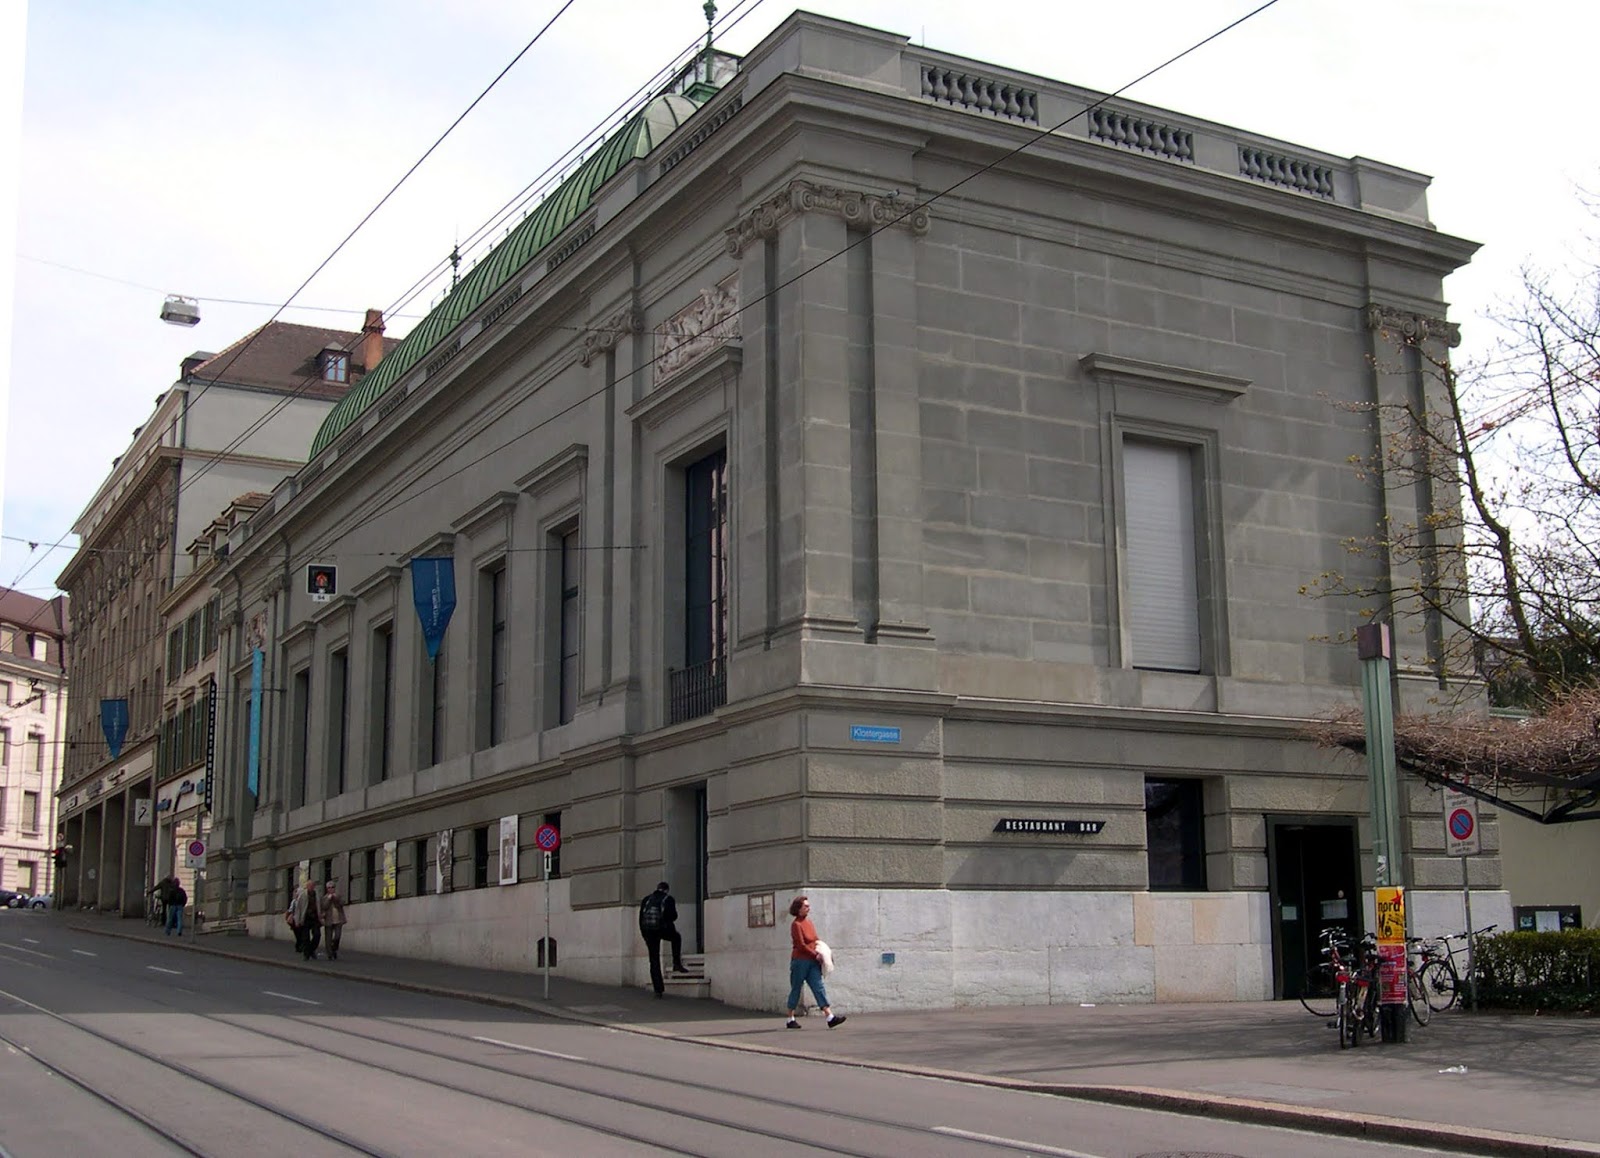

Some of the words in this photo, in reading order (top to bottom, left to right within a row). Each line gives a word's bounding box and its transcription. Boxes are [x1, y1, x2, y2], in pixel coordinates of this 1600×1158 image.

[854, 727, 898, 739] Klostergasse
[1005, 821, 1066, 831] RESTAURANT
[1080, 823, 1097, 831] BAR
